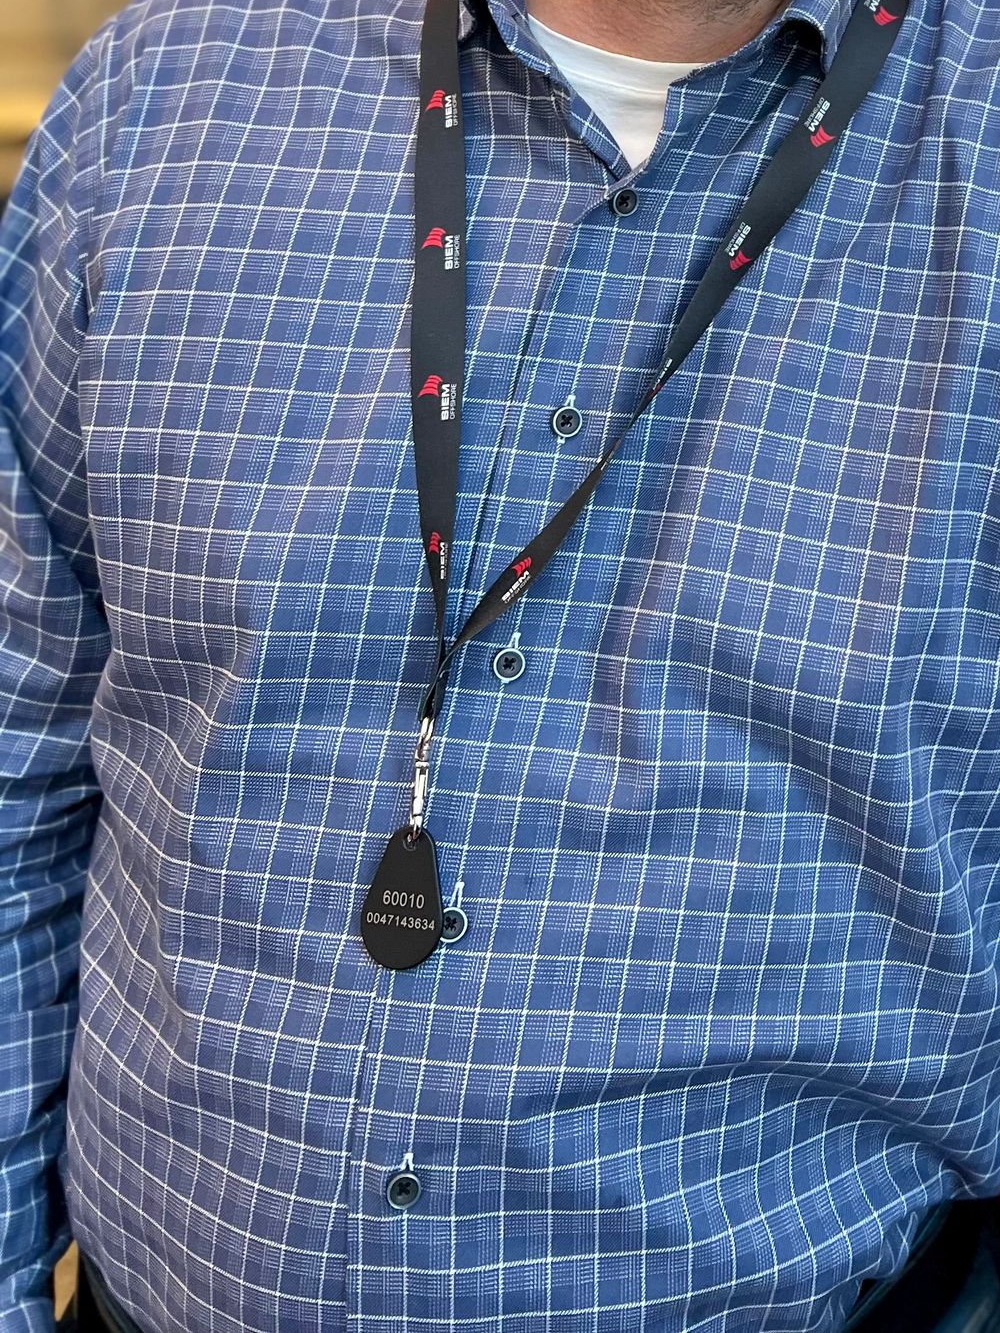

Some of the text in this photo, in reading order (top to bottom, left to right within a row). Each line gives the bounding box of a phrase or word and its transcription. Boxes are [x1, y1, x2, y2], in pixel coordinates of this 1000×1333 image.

[808, 100, 831, 132] SIEM
[444, 235, 454, 270] SIEM
[728, 225, 751, 257] SIEM
[441, 383, 450, 421] SIEM
[501, 570, 530, 602] SIEM
[383, 890, 425, 909] 60010
[366, 911, 436, 931] 0047143634
